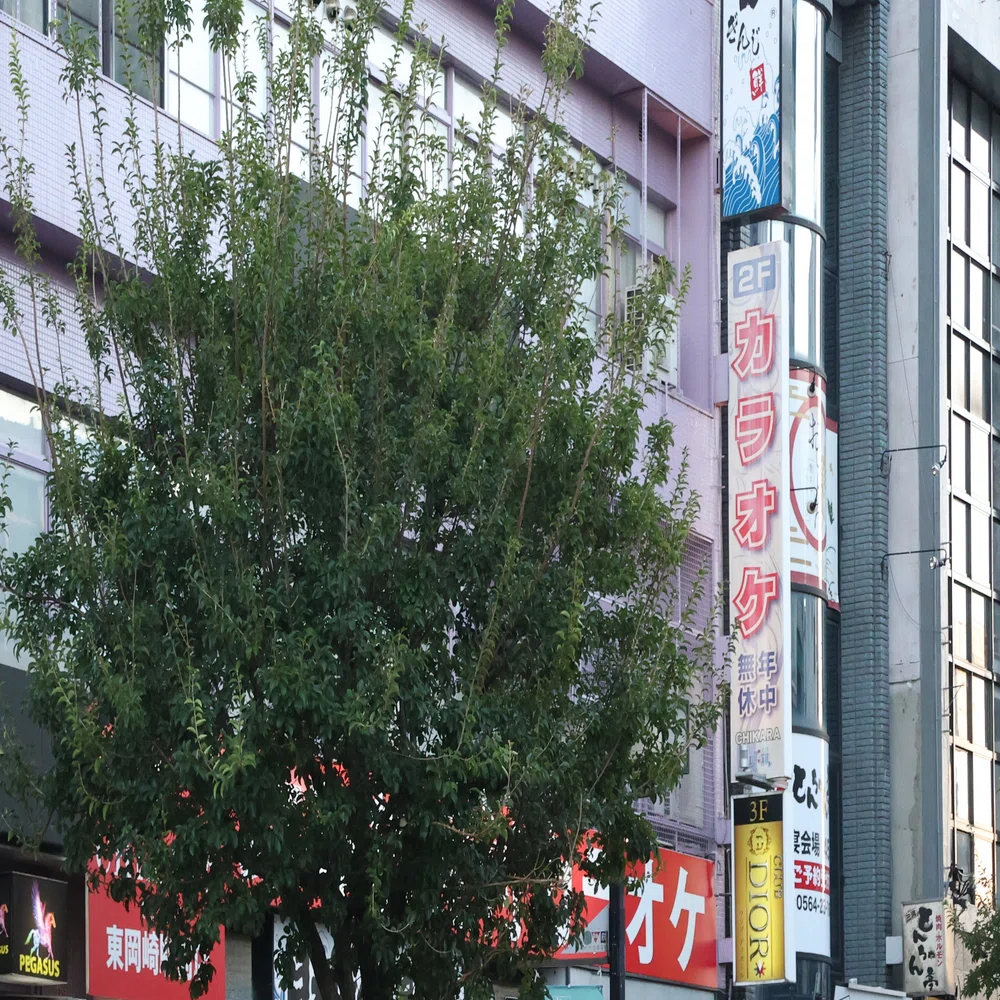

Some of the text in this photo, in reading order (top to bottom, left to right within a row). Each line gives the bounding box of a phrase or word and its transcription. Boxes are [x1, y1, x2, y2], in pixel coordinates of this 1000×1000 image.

[737, 260, 771, 293] 2F
[731, 307, 778, 640] カラオケ
[735, 727, 781, 745] CHIKARA
[749, 799, 769, 822] 3F
[748, 861, 770, 961] DIOR
[19, 953, 60, 978] PEGASUS
